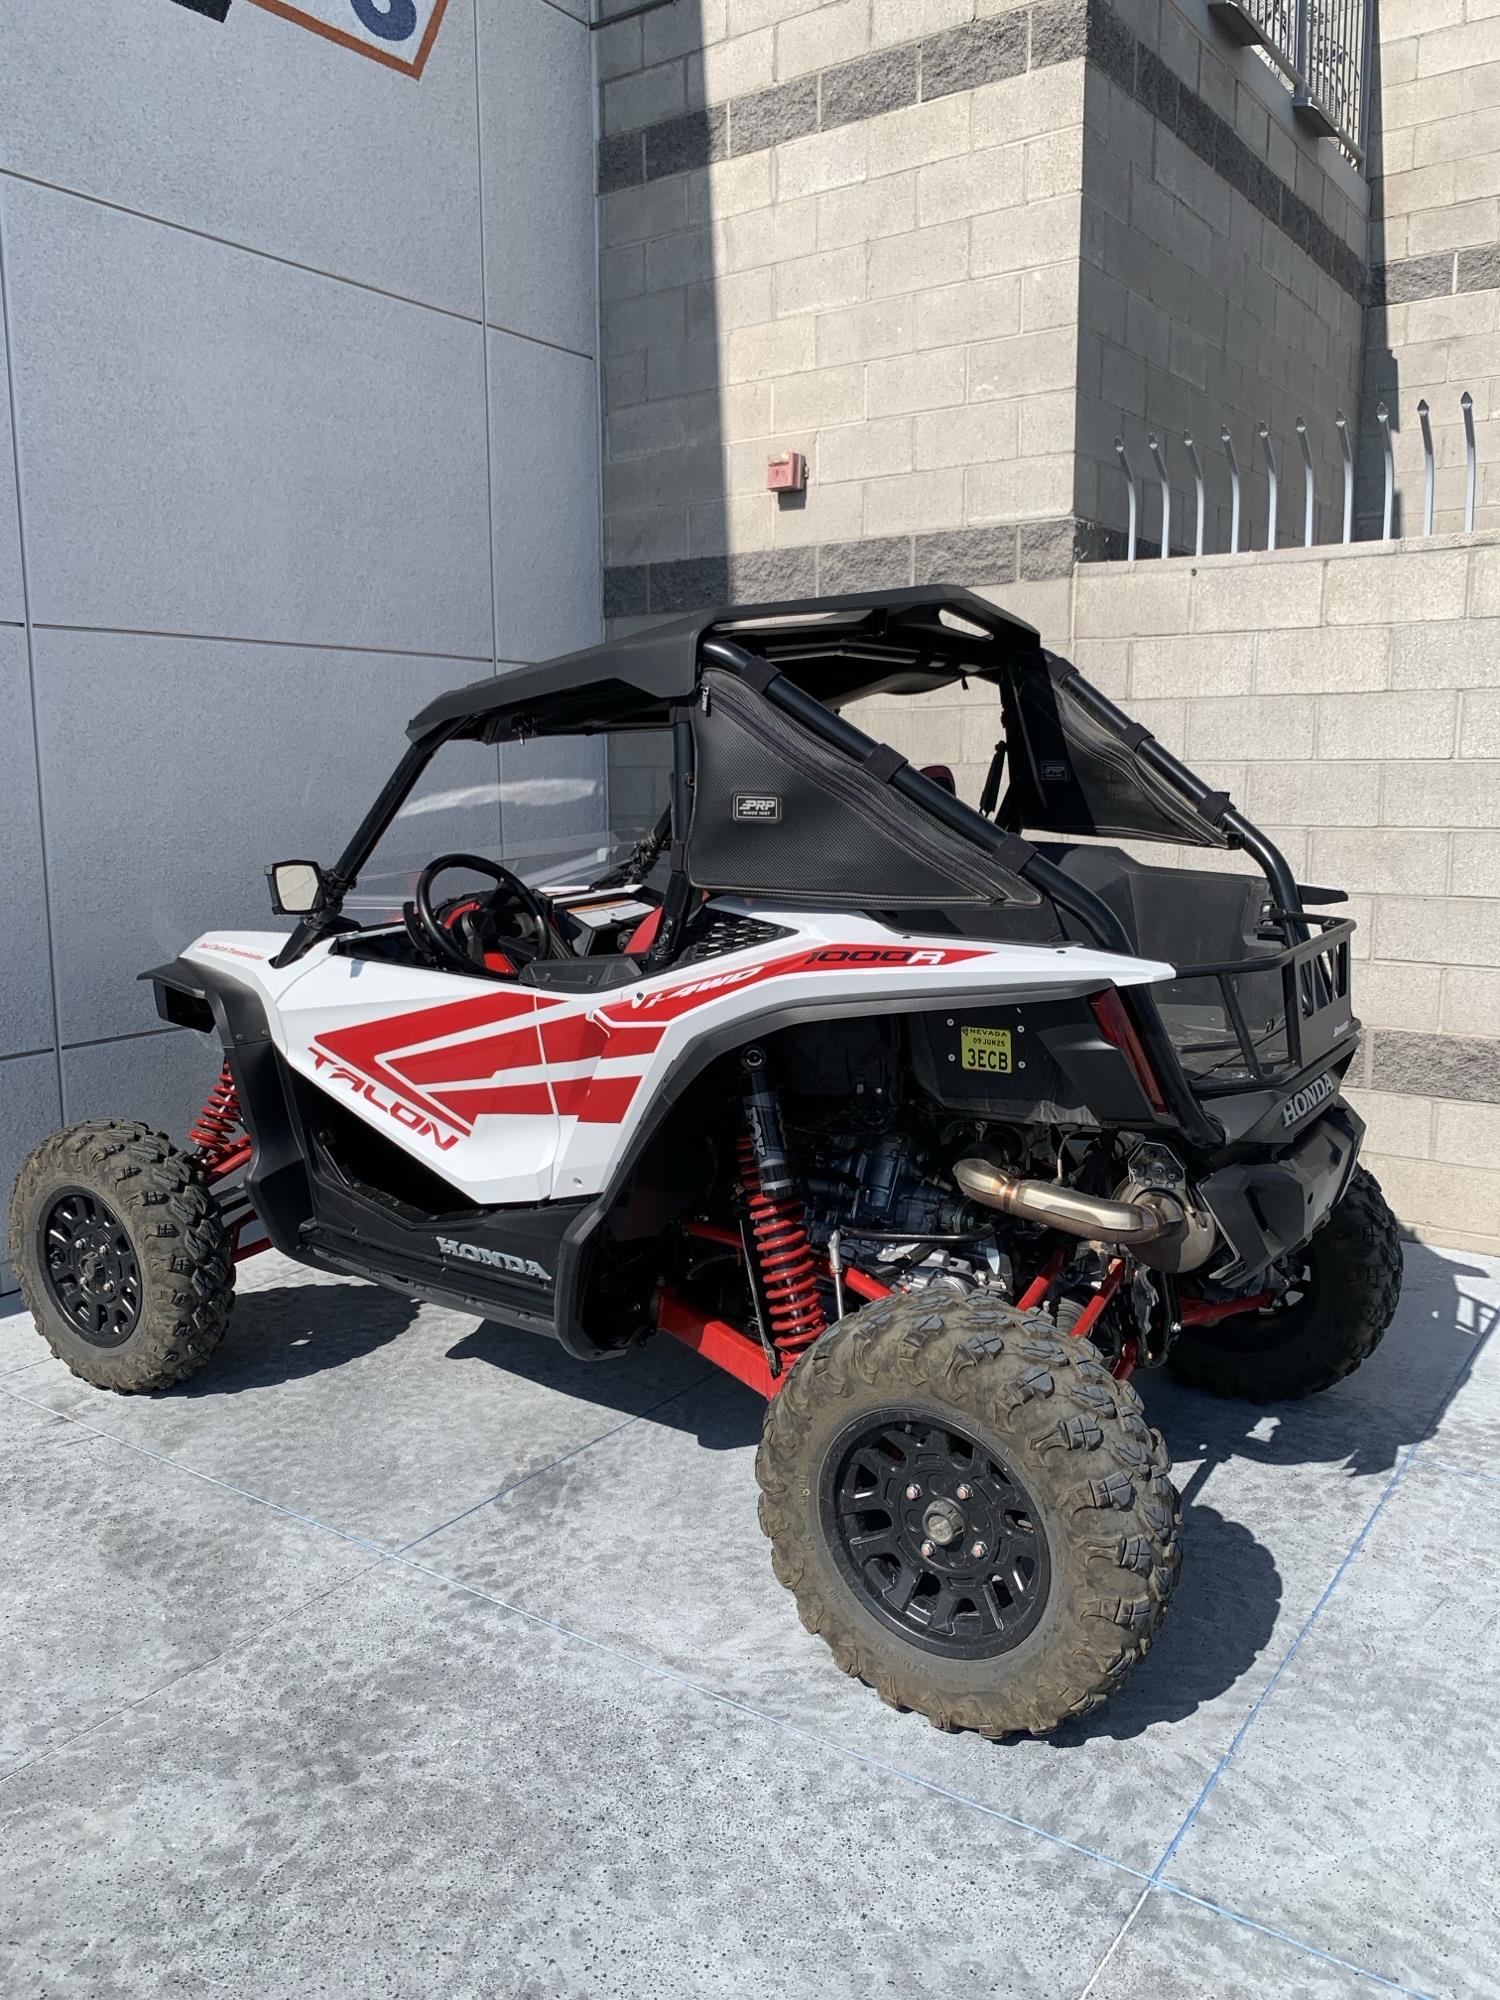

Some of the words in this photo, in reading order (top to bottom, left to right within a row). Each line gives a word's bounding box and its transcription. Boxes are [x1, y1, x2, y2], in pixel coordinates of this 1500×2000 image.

[739, 800, 776, 810] PRP
[970, 1028, 1007, 1038] NEVADA
[967, 1048, 1008, 1071] 3ECB
[308, 1046, 460, 1152] TALON
[1282, 1072, 1336, 1127] HONDA
[436, 1236, 552, 1281] HONDA
